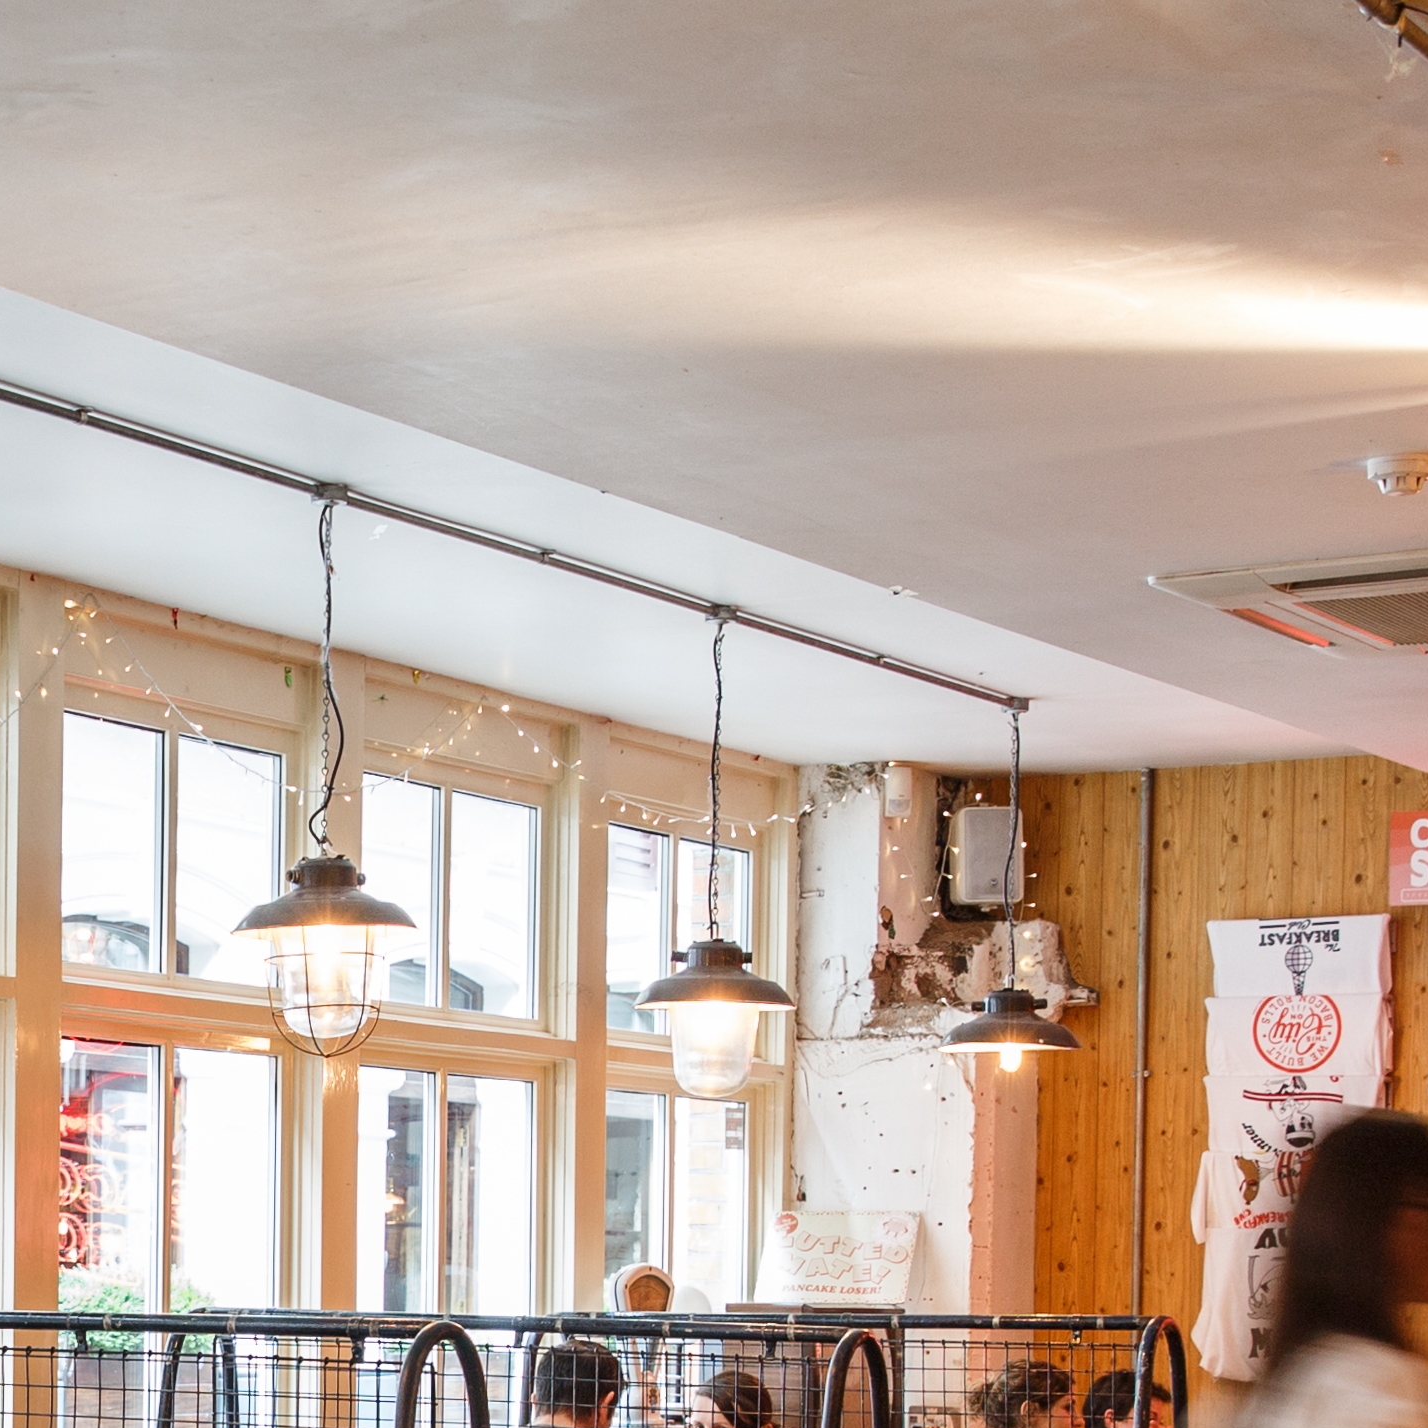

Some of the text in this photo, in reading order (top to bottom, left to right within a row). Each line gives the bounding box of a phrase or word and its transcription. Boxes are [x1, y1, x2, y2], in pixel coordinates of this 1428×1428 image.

[1258, 929, 1340, 947] BREAKFAST
[1261, 995, 1334, 1025] BACON ROLLS
[1266, 1044, 1329, 1067] WE BUILT
[782, 1283, 882, 1295] PANCAKE LOSER!
